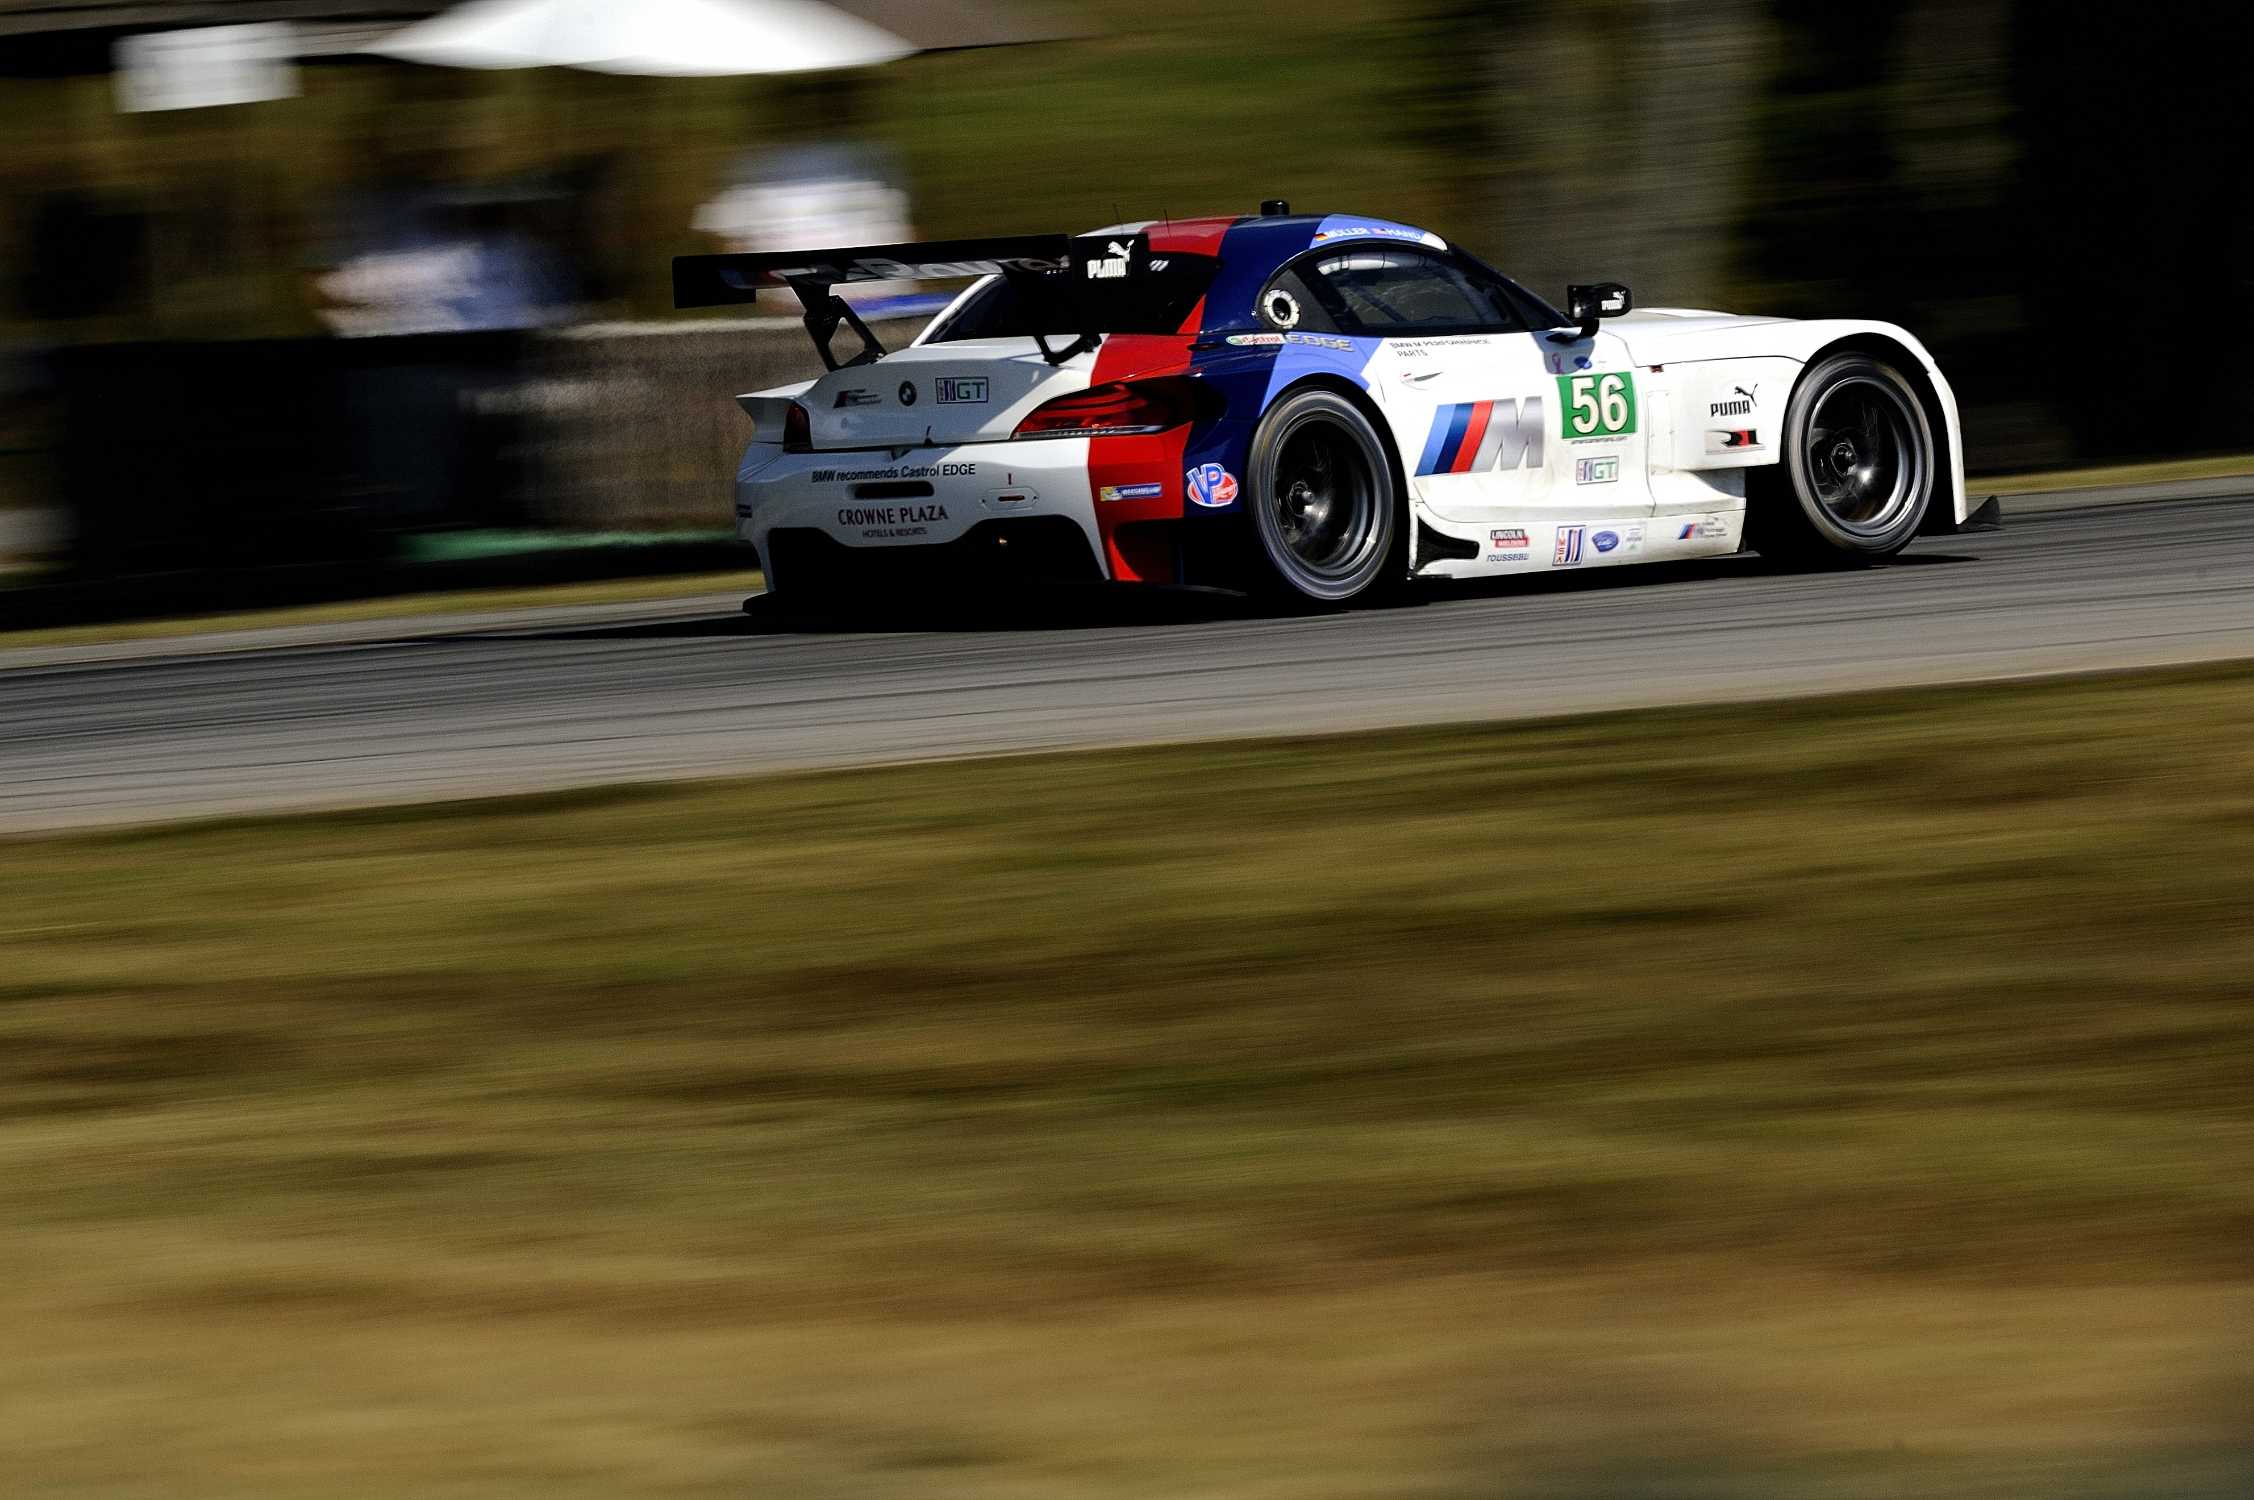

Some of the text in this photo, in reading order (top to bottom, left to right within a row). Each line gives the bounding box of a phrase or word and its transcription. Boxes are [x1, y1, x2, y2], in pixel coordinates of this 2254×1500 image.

[1087, 258, 1126, 278] PUMA
[1285, 334, 1355, 352] EDGE
[957, 382, 985, 400] GT
[1571, 373, 1628, 434] 56
[1710, 400, 1751, 417] PUMA
[1470, 396, 1545, 473] M
[811, 463, 977, 483] BMW recommends Castrol EDGE
[1594, 461, 1617, 479] GT
[838, 504, 949, 526] CROWNE PLAZA
[862, 529, 888, 538] HOTELS
